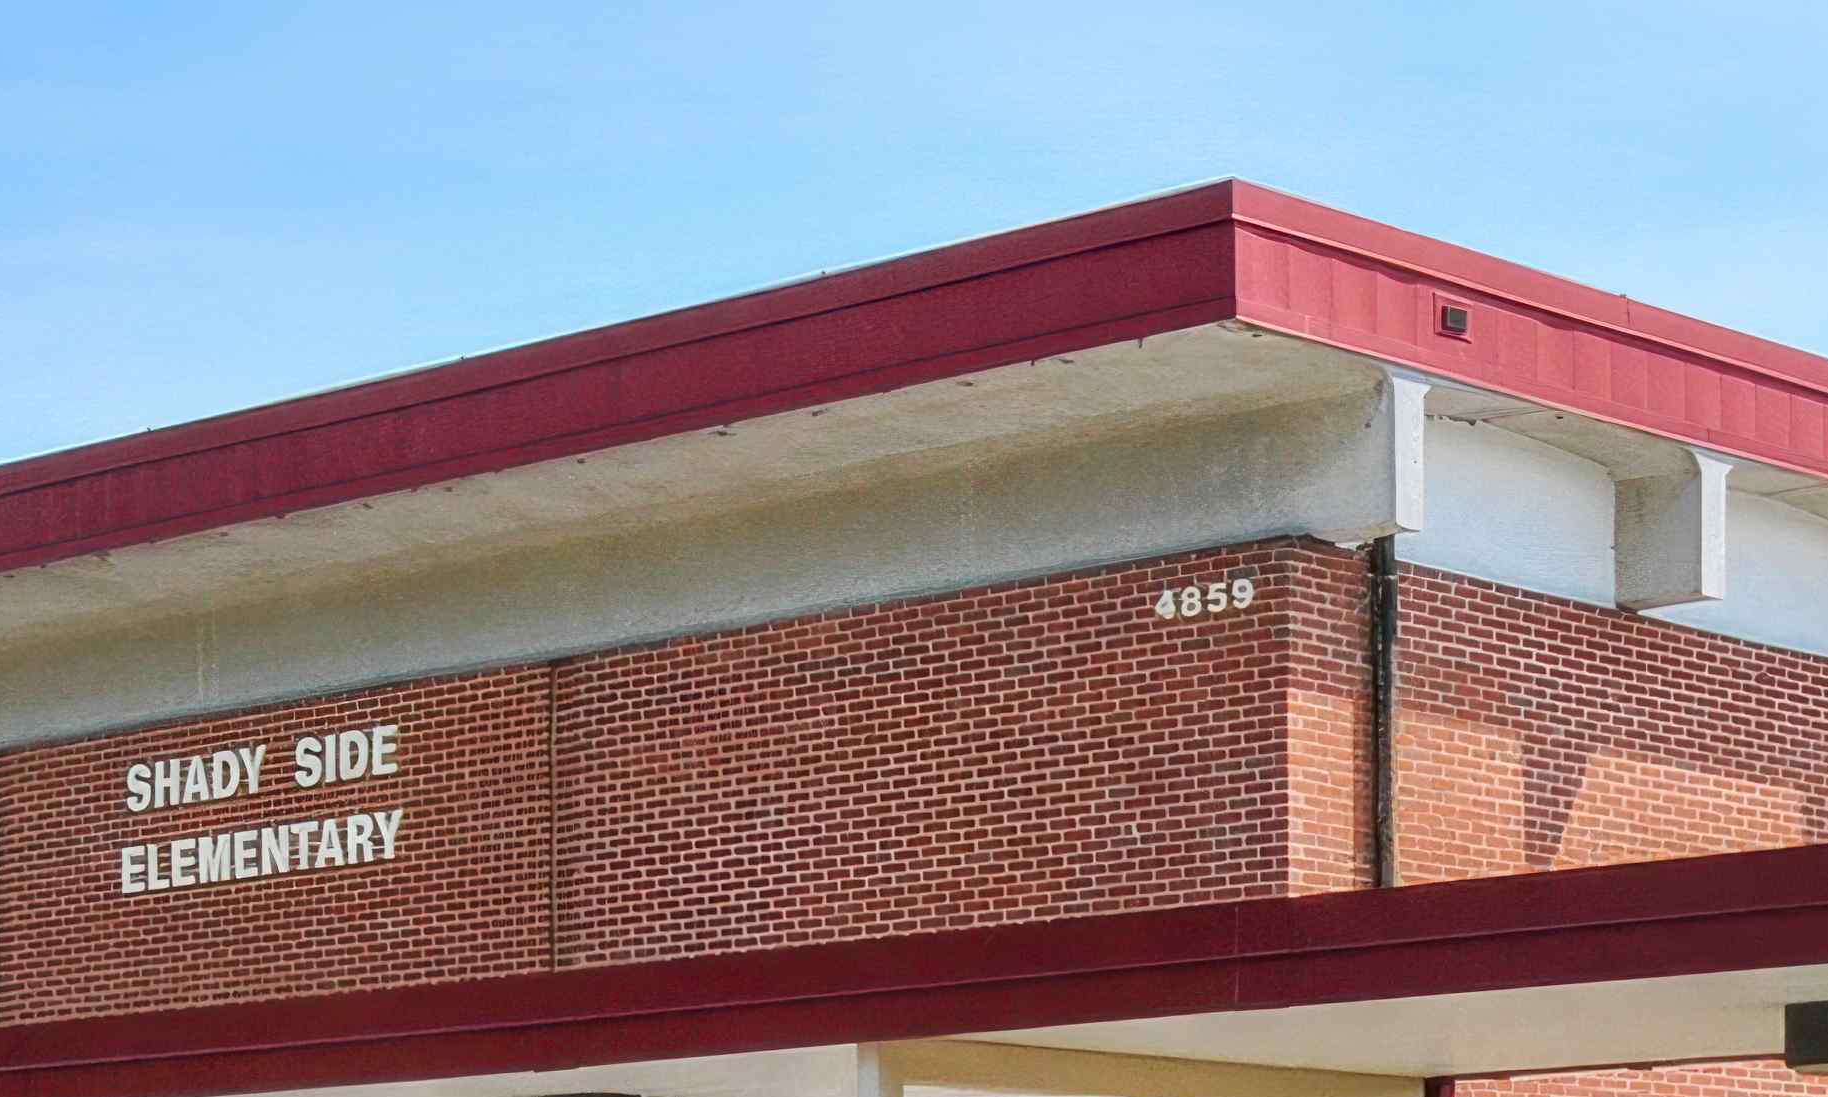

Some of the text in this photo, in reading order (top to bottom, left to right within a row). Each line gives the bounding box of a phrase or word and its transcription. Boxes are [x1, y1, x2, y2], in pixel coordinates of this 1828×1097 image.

[1155, 578, 1254, 619] 4859
[126, 724, 399, 812] SHADY SIDE
[121, 809, 404, 894] ELEMENTARY
